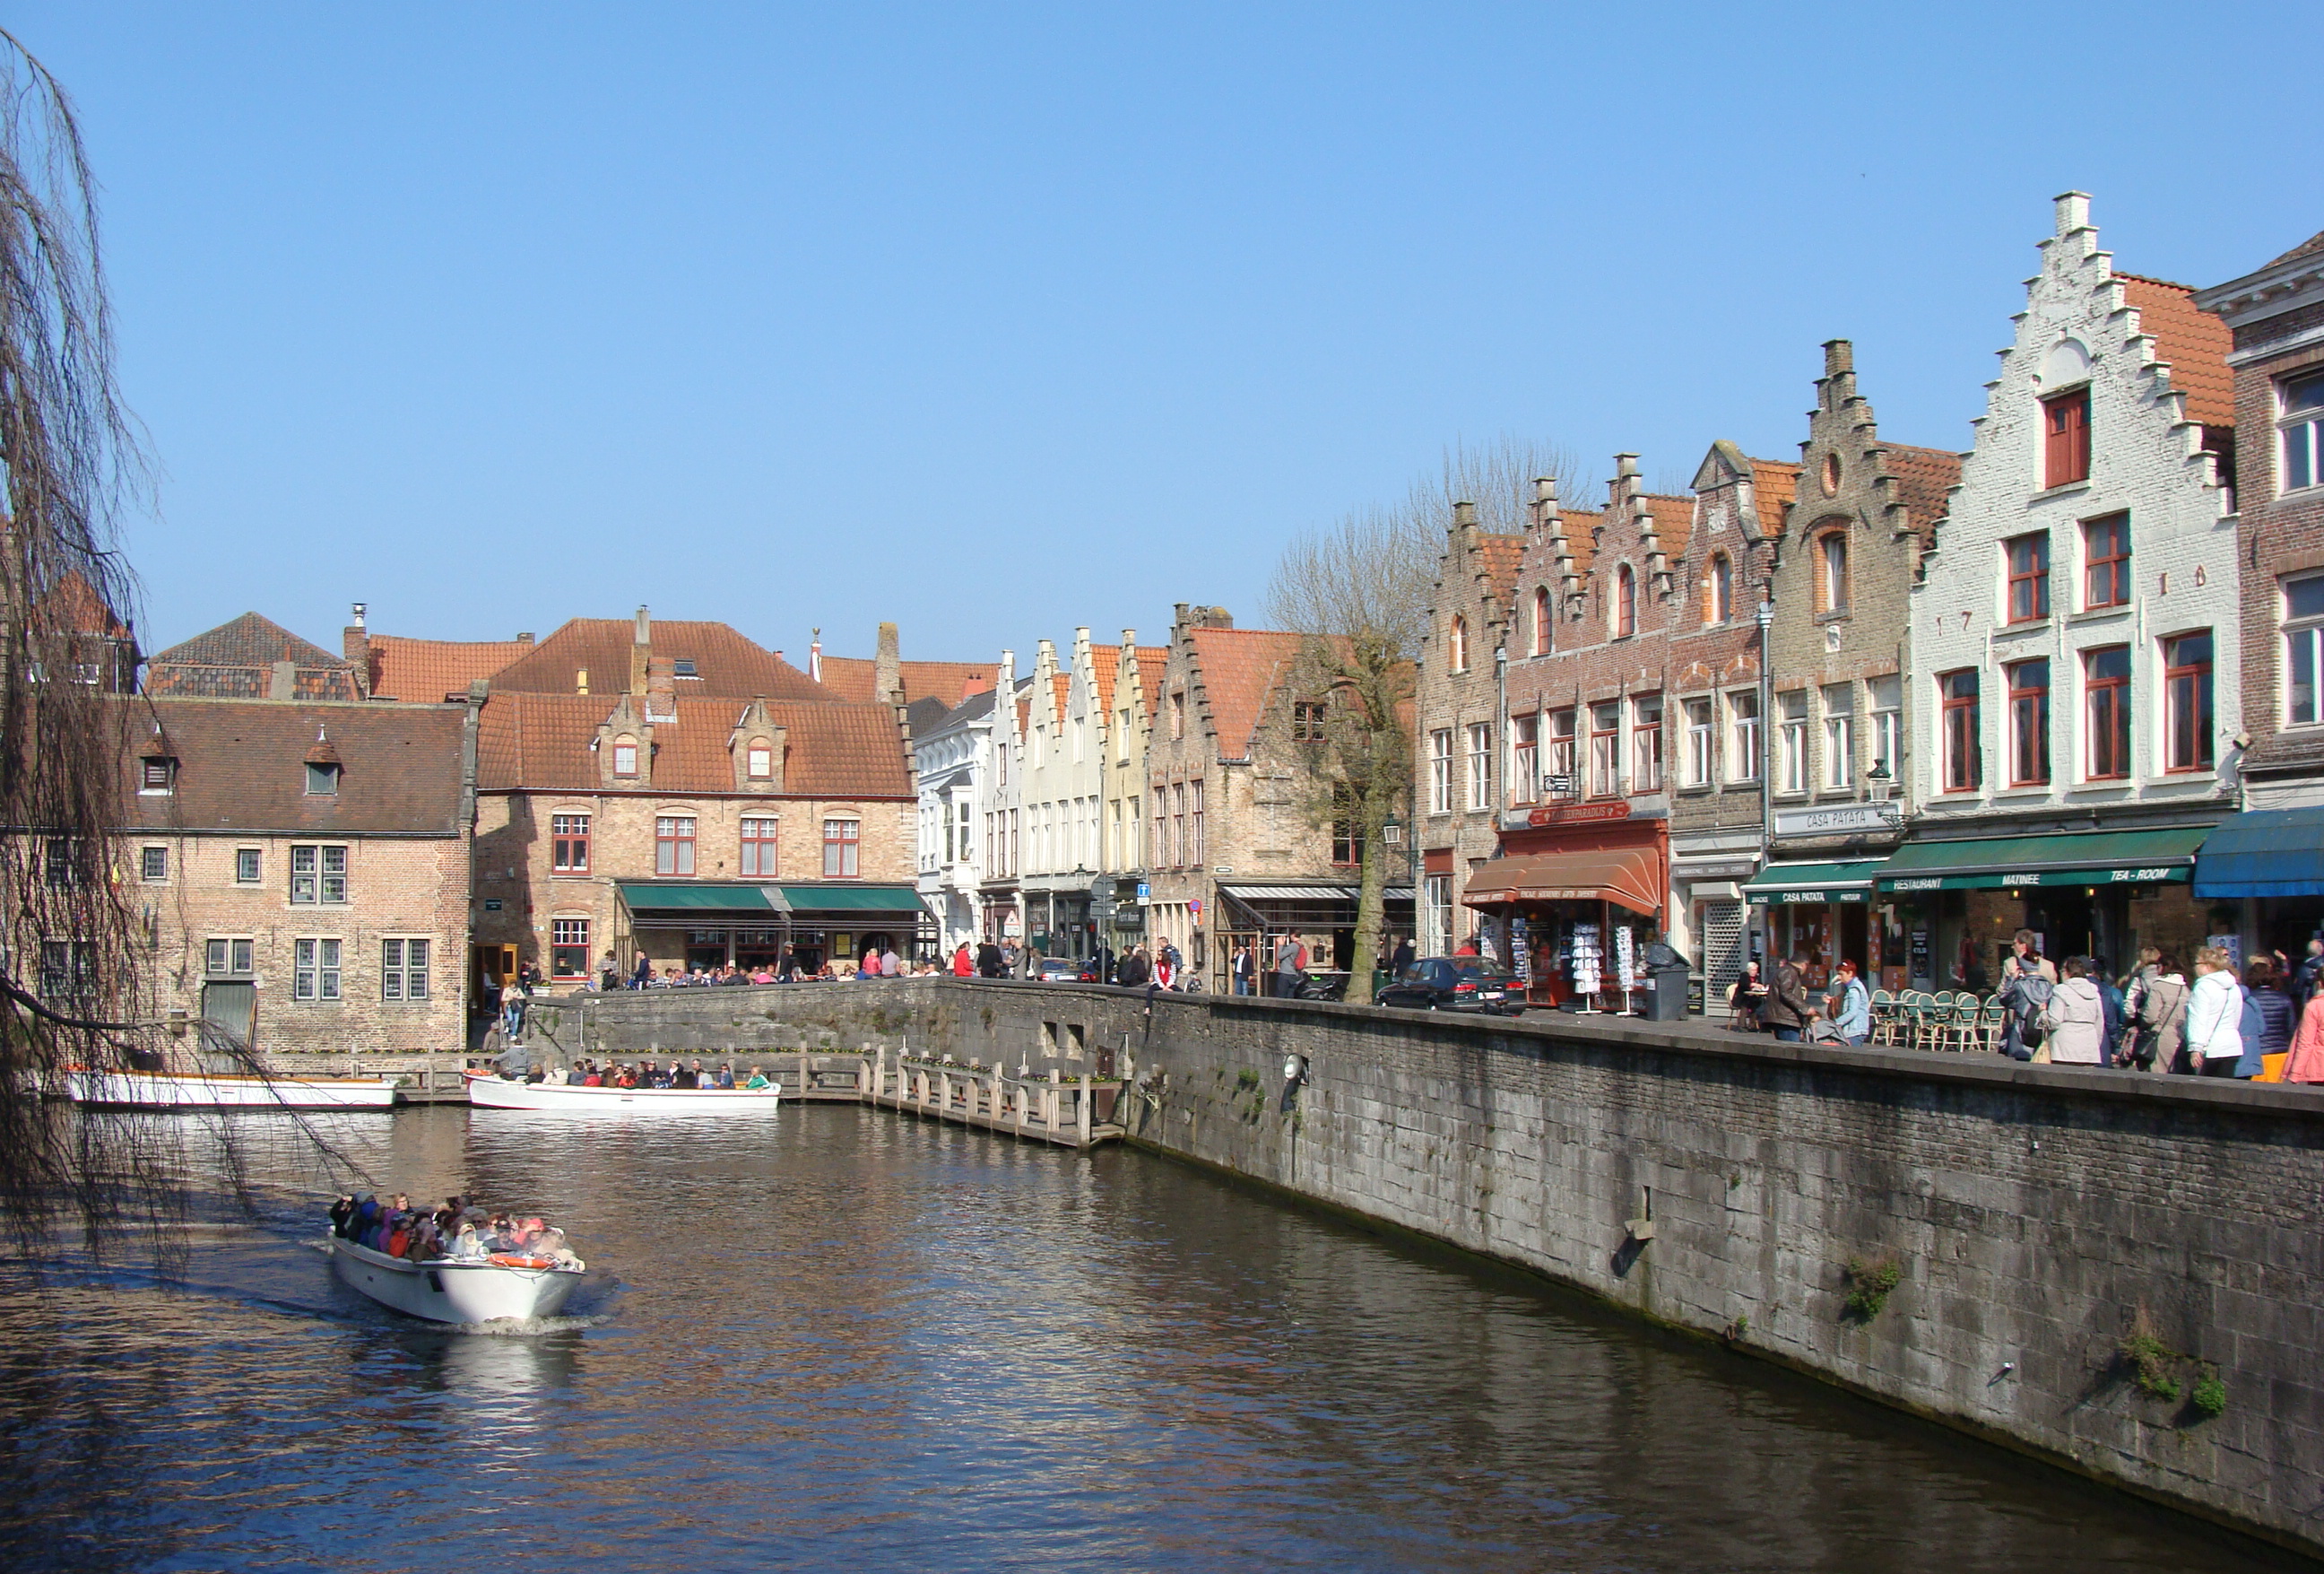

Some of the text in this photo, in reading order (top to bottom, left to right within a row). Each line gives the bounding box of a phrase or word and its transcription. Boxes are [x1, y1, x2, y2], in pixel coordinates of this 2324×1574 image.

[1807, 811, 1866, 828] CASA PATATA
[1894, 878, 1943, 890] RESTAURANT
[2002, 874, 2040, 885] MATINEE
[2111, 871, 2130, 881] TEA
[2136, 868, 2170, 880] ROOM
[1782, 892, 1800, 902] CASA
[1801, 891, 1825, 901] PATATA
